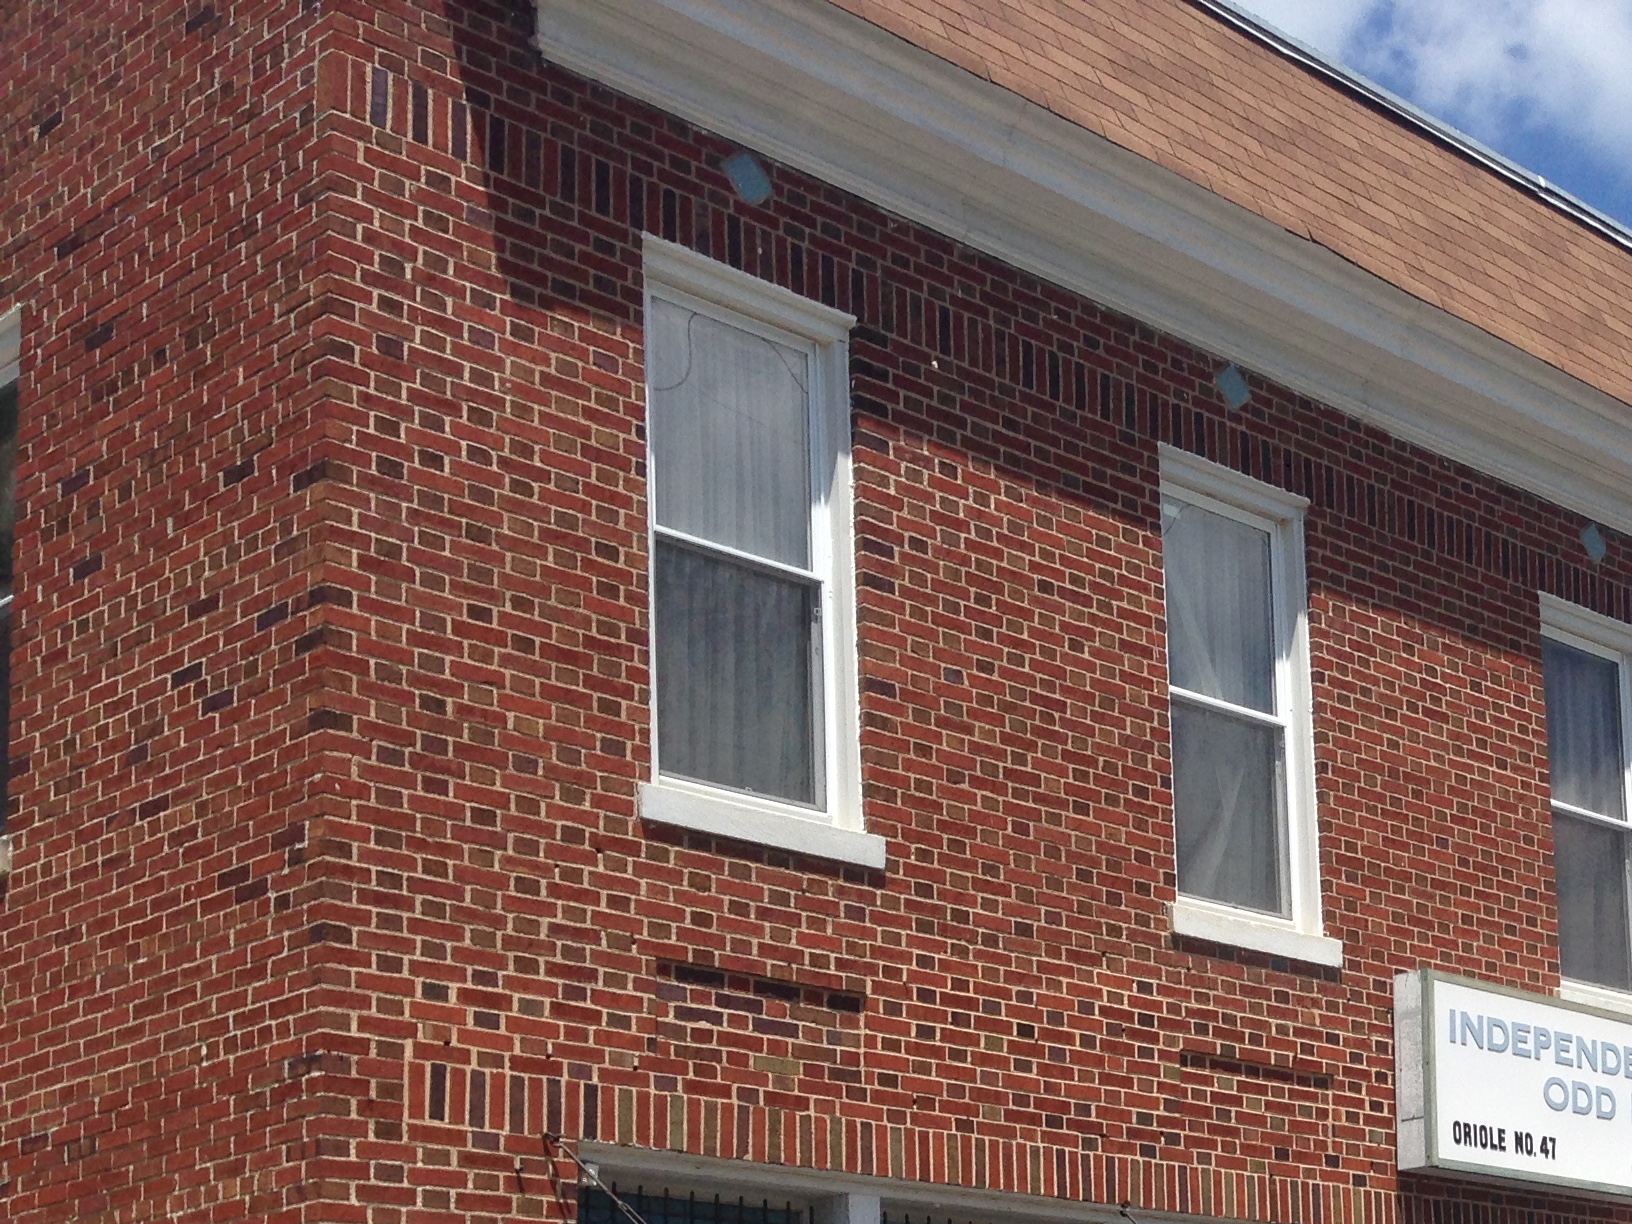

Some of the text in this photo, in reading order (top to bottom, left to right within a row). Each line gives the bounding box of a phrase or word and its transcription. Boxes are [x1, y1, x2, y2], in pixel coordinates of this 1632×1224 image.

[1543, 1077, 1616, 1120] ODD
[1453, 1120, 1556, 1160] ORIOLE NO. 47
